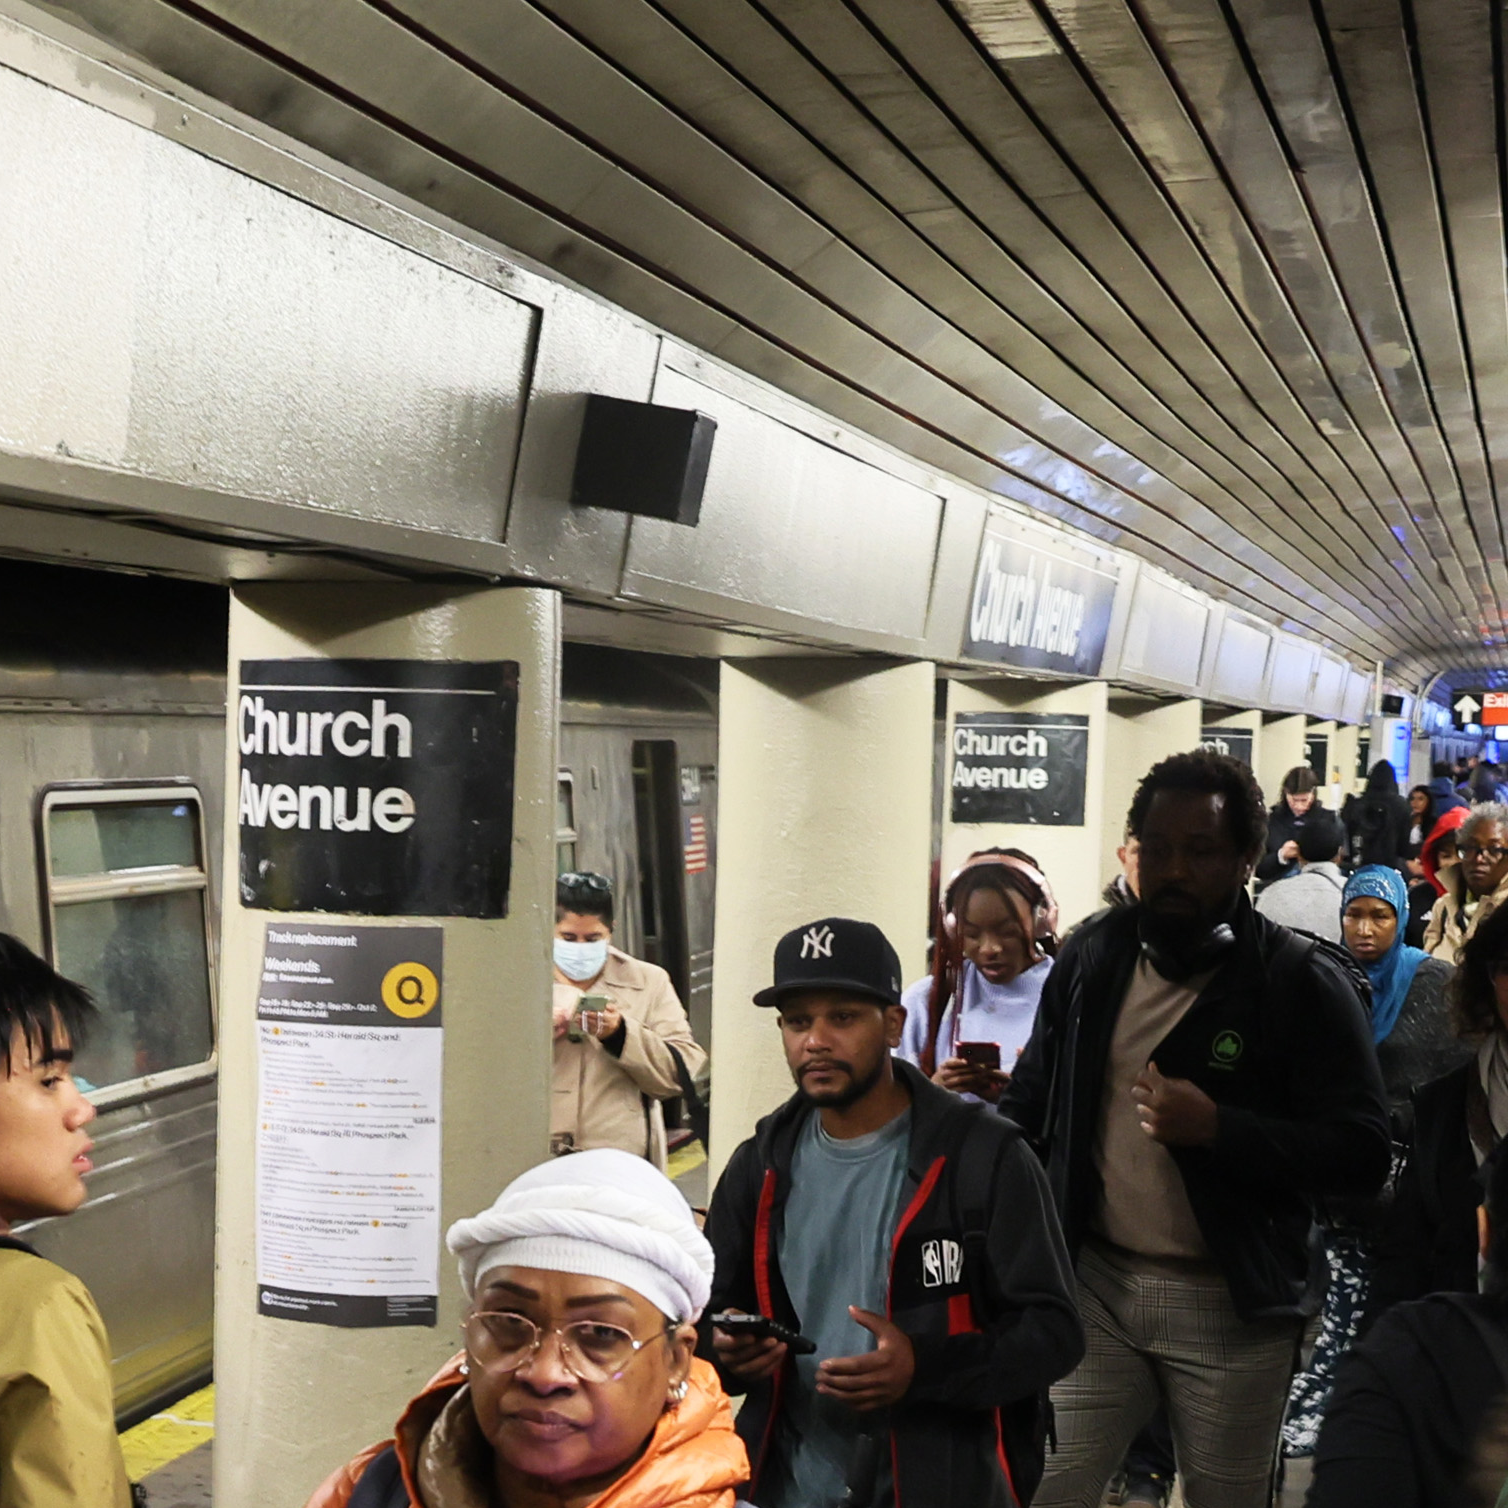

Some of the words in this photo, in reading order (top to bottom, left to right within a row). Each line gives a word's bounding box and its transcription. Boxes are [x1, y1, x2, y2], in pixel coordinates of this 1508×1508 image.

[971, 540, 1036, 647] Church
[1030, 561, 1084, 657] Avenue
[238, 694, 412, 758] Church
[954, 729, 1048, 757] Church
[953, 761, 1049, 790] Avenue
[238, 768, 416, 834] Avenue
[800, 924, 835, 959] NY
[396, 976, 426, 1006] Q
